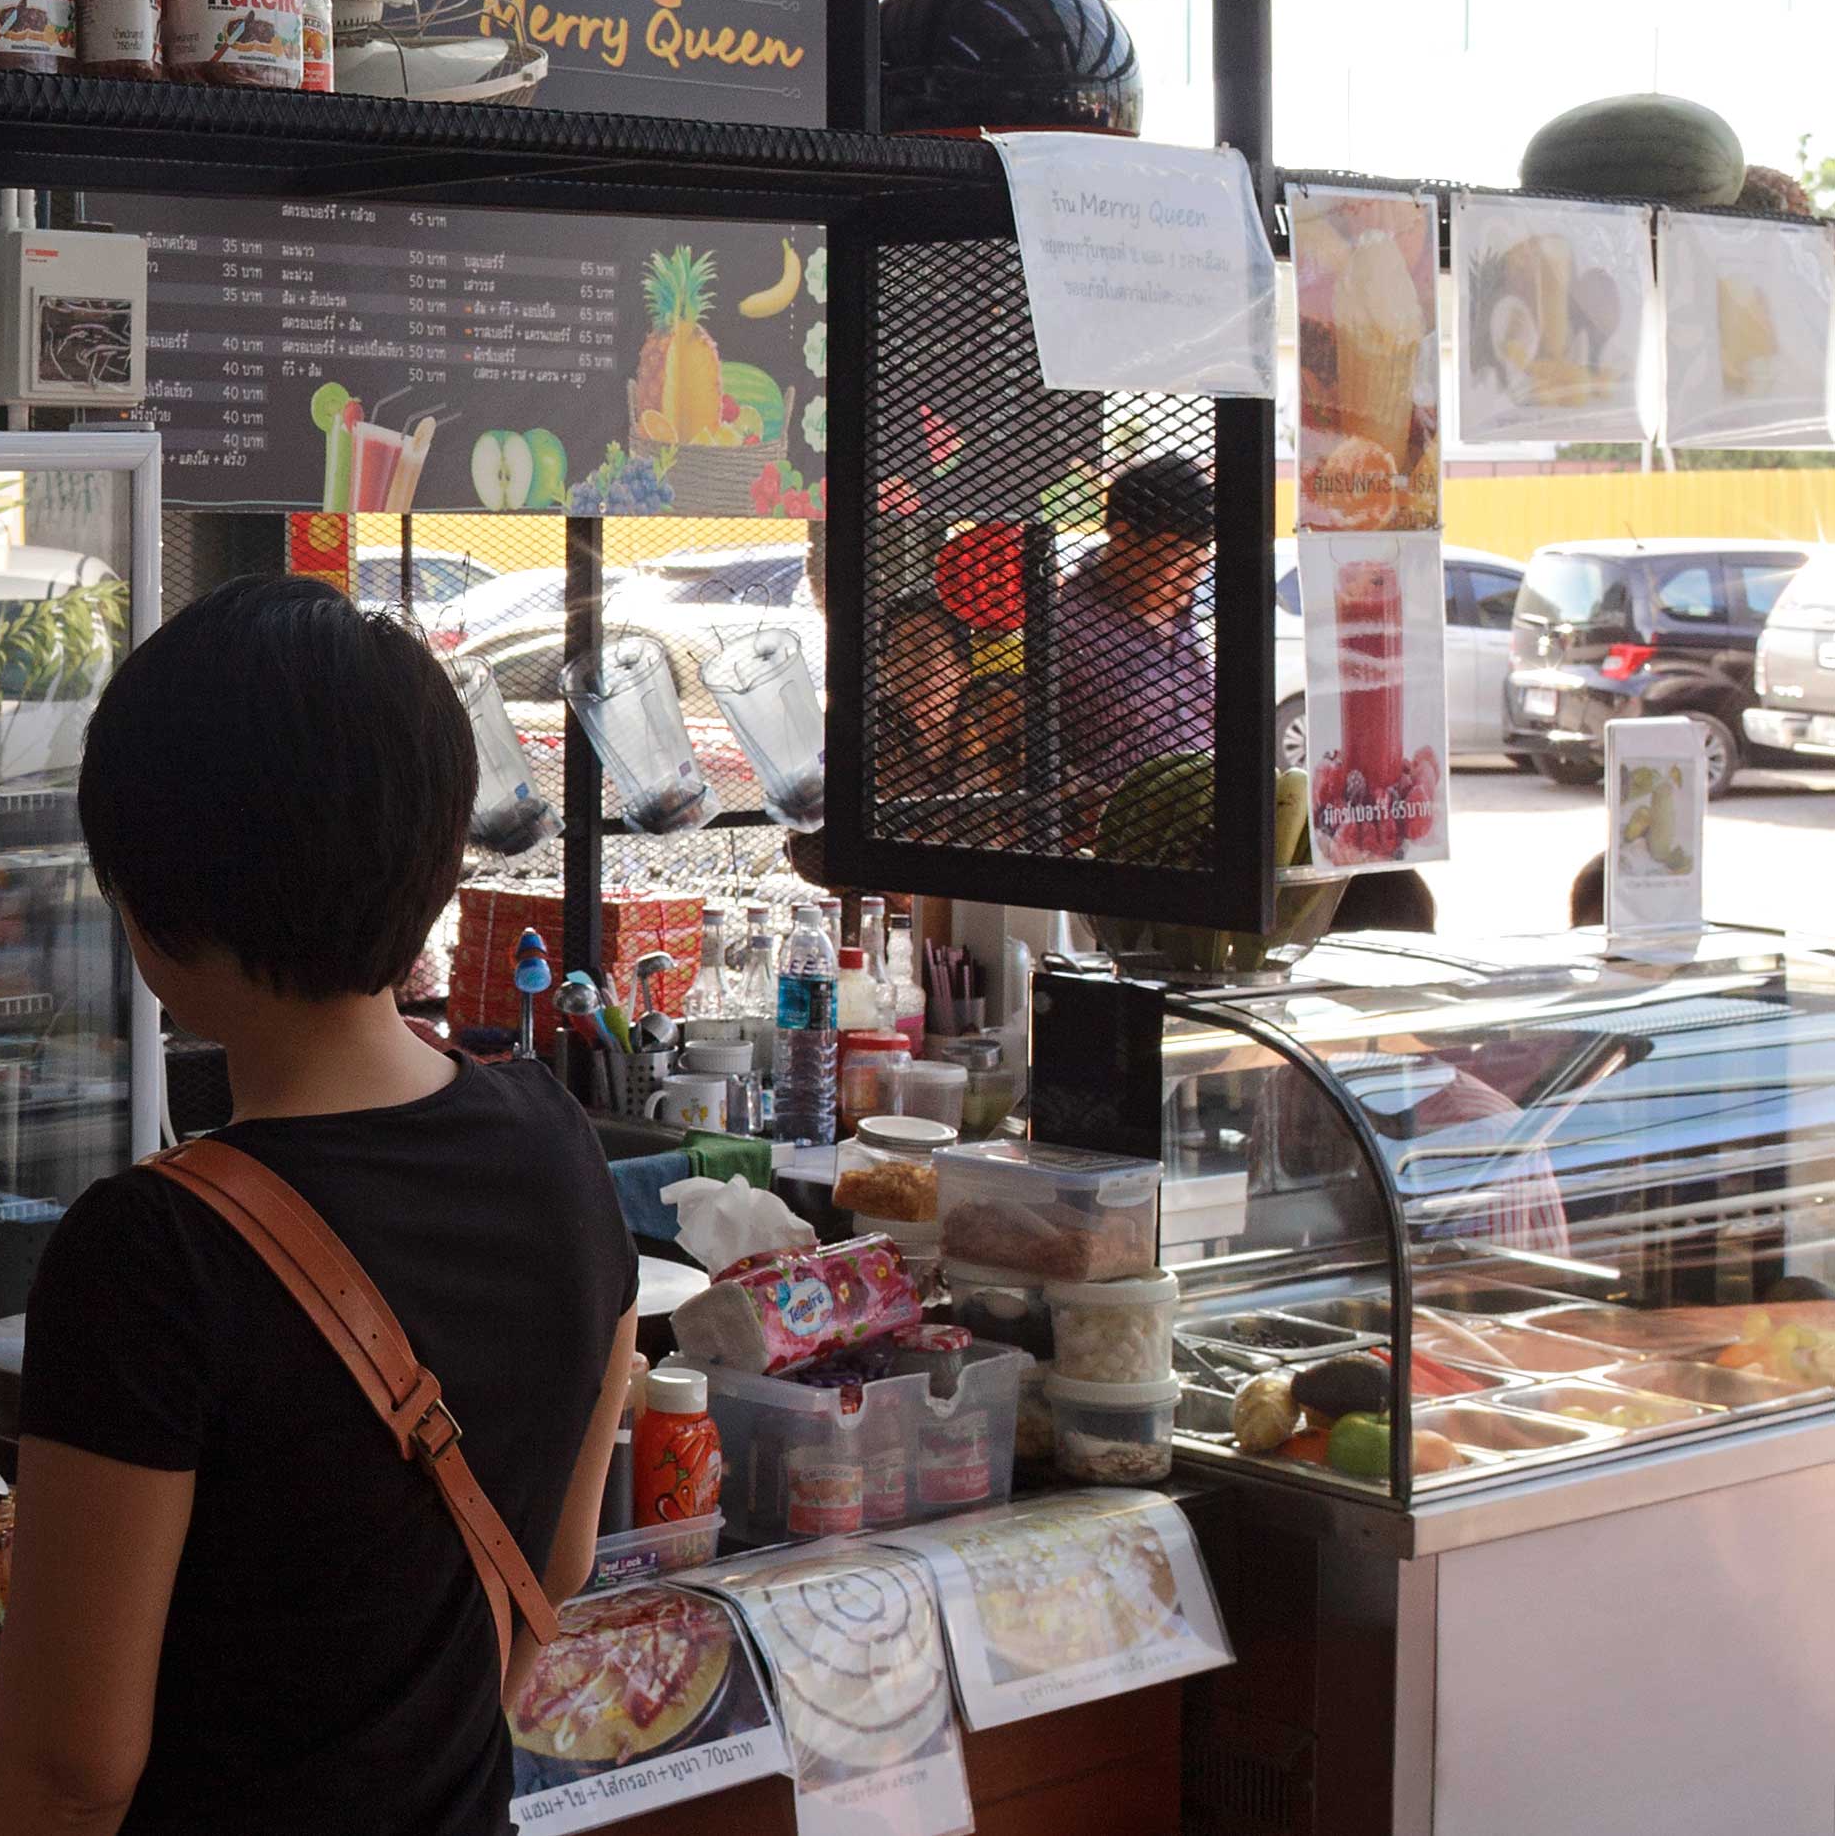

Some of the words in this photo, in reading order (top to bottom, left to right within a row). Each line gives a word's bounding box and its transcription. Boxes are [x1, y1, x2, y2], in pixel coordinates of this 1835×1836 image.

[645, 7, 805, 70] Queen
[350, 207, 377, 224] กล้วย
[408, 211, 424, 226] 45
[427, 214, 447, 228] บาท
[1079, 190, 1141, 230] Merry
[1148, 198, 1209, 230] Queen
[222, 238, 238, 254] 35
[242, 242, 263, 255] บาท
[281, 244, 316, 259] มะนาว
[408, 250, 424, 265] 50
[427, 254, 447, 267] บาท
[222, 262, 238, 278] 35
[242, 266, 263, 279] บาท
[580, 261, 595, 277] 65
[596, 264, 616, 278] บาท
[281, 267, 315, 283] มะม่วง
[408, 274, 424, 289] 50
[427, 278, 447, 291] บาท
[222, 286, 238, 302] 35
[242, 290, 263, 303] บาท
[580, 284, 594, 300] 65
[596, 287, 615, 301] บาท
[281, 290, 296, 306] ส้ม
[309, 291, 348, 308] สับปะรด
[408, 297, 424, 313] 50
[427, 301, 447, 314] บาท
[579, 307, 594, 322] 65
[596, 310, 614, 324] บาท
[348, 316, 362, 332] ส้ม
[408, 320, 424, 336] 50
[426, 324, 447, 337] บาท
[222, 336, 239, 351] 40
[242, 340, 264, 352] บาท
[579, 329, 593, 345] 65
[595, 332, 614, 347] บาท
[408, 343, 424, 359] 50
[426, 347, 446, 360] บาท
[222, 360, 239, 376] 40
[242, 364, 264, 377] บาท
[578, 352, 593, 368] 65
[594, 355, 613, 370] บาท
[307, 362, 322, 378] ส้ม
[407, 367, 423, 382] 50
[426, 370, 446, 384] บาท
[222, 384, 239, 400] 40
[242, 388, 264, 401] บาท
[222, 409, 239, 424] 40
[242, 413, 264, 426] บาท
[222, 433, 239, 449] 40
[242, 437, 264, 450] บาท
[1314, 469, 1398, 496] ส้มSUNKIS
[703, 1738, 755, 1775] 70บาท
